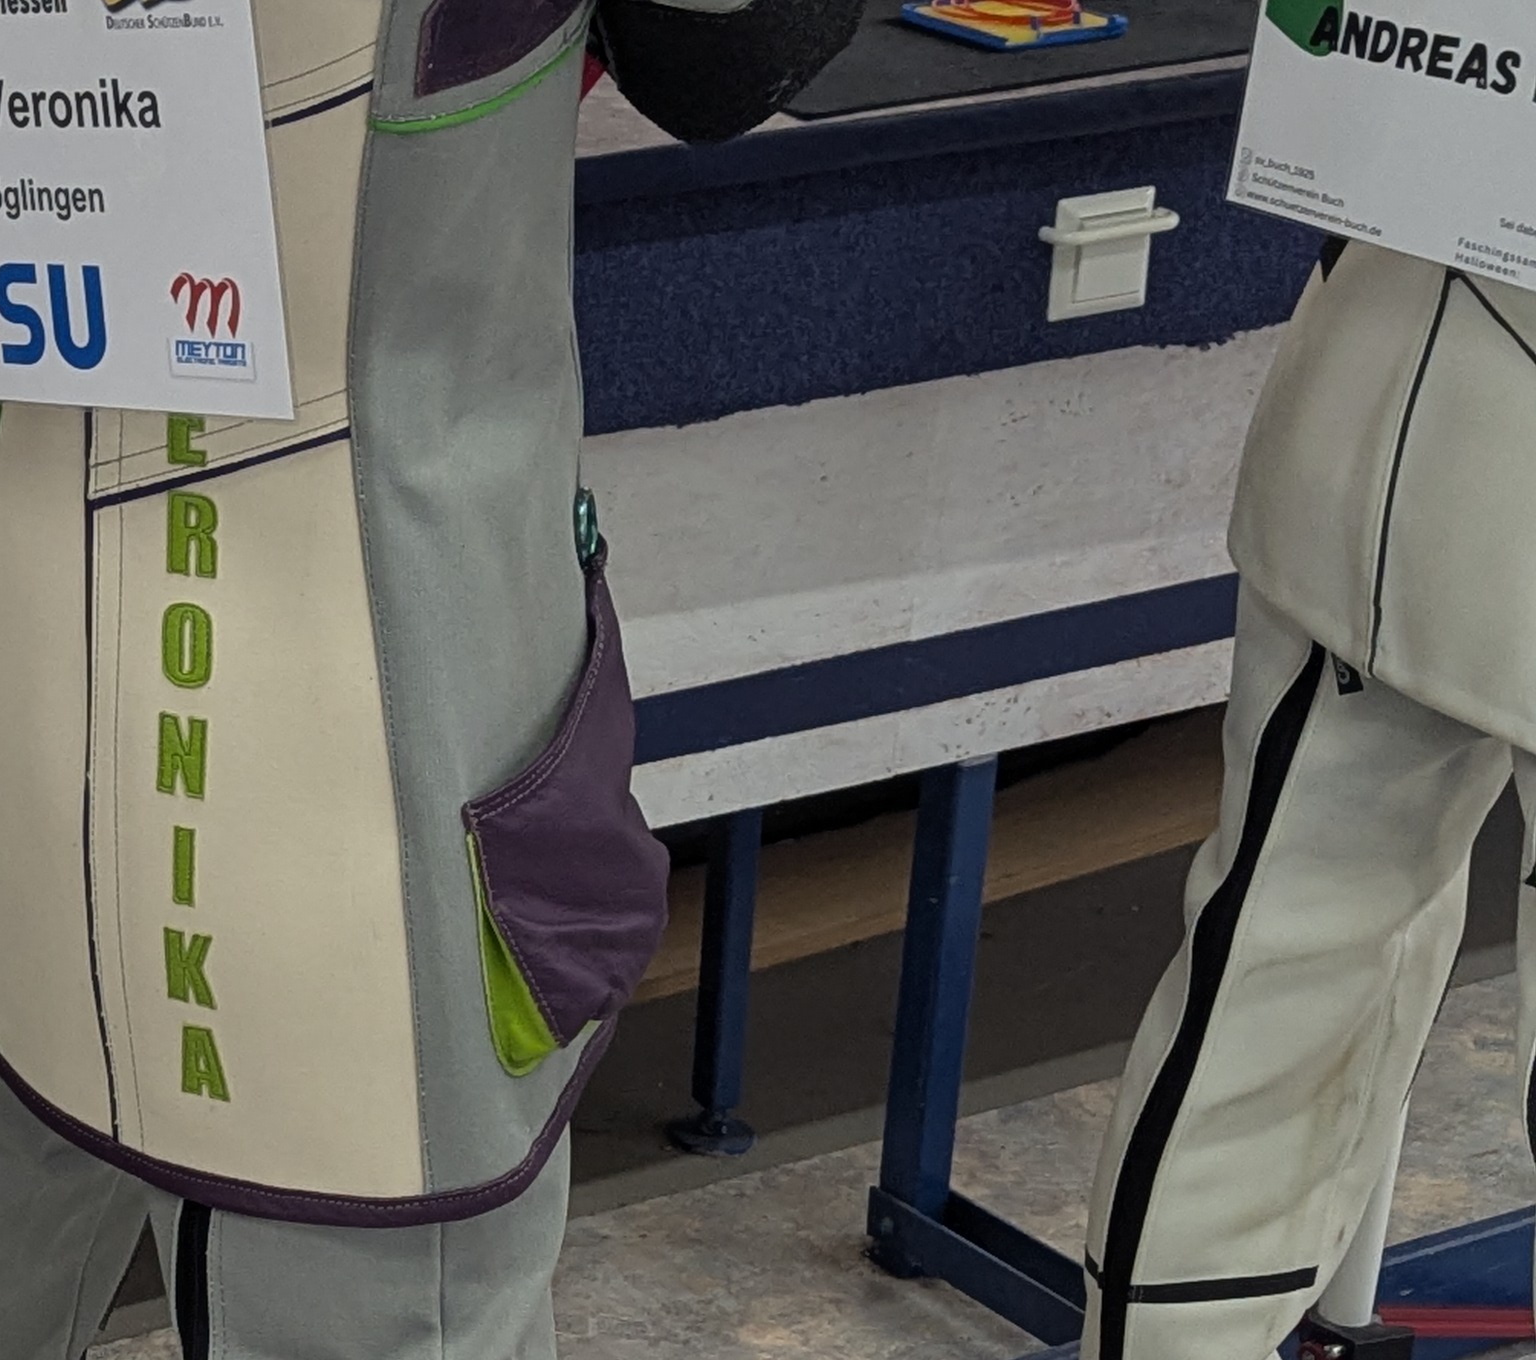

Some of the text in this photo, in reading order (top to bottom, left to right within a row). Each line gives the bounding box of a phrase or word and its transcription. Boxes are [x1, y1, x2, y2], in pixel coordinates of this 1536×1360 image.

[1309, 5, 1522, 95] ANDREAS
[1321, 192, 1345, 208] Buch
[175, 339, 246, 360] MEYTON
